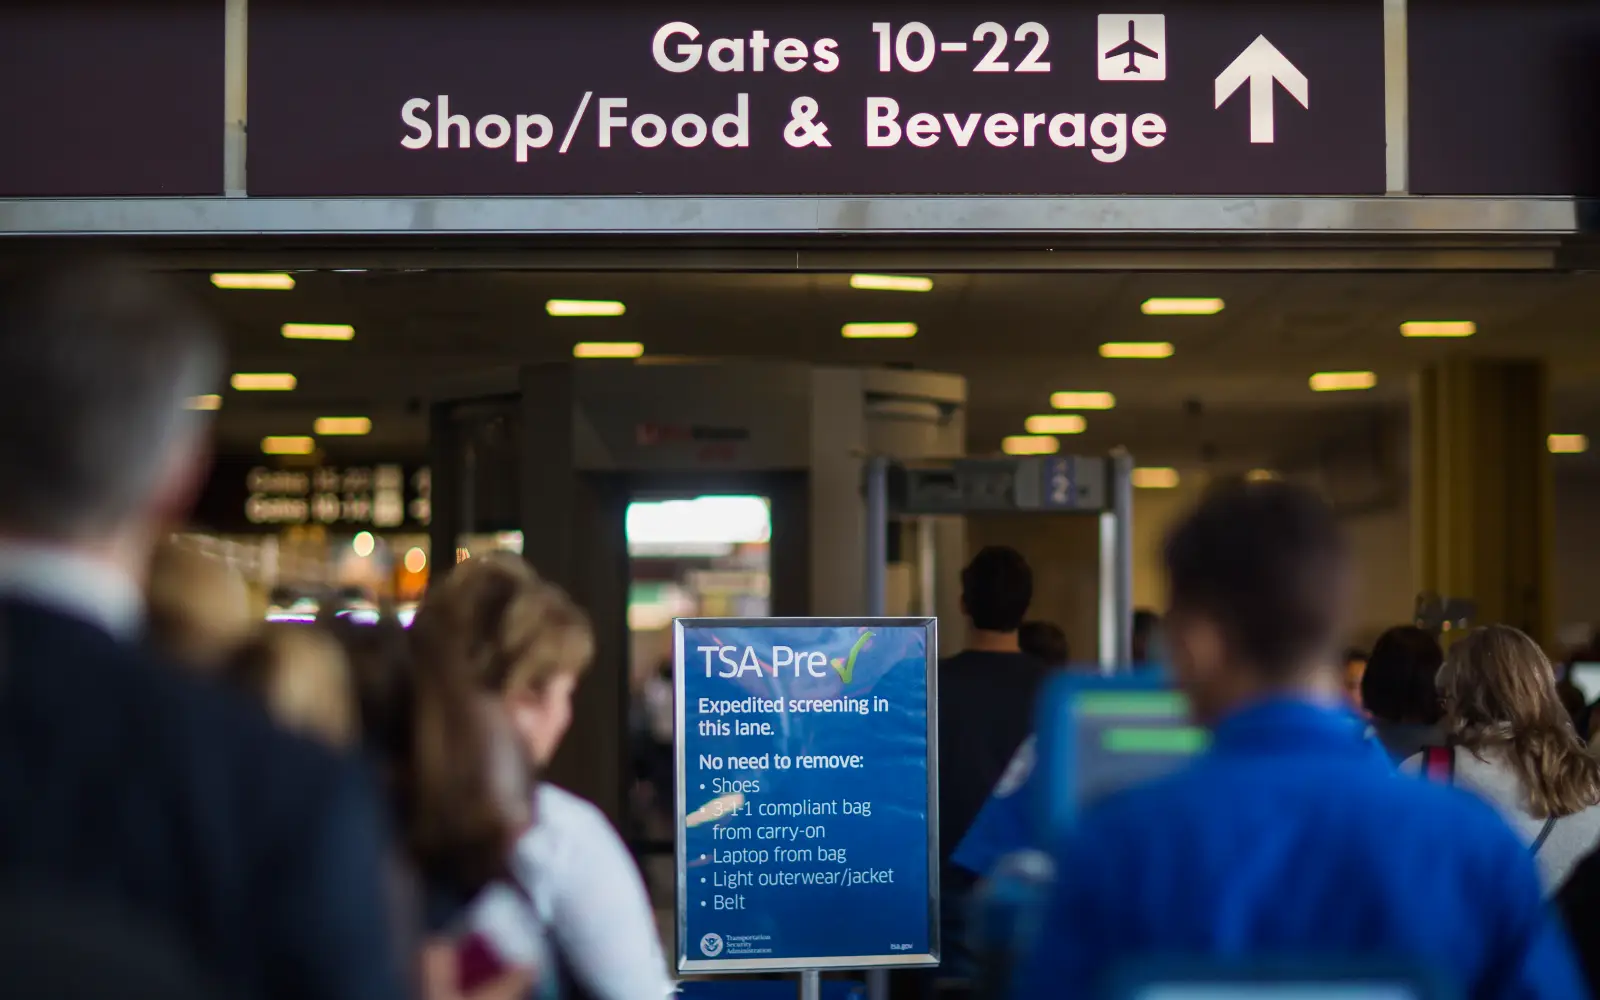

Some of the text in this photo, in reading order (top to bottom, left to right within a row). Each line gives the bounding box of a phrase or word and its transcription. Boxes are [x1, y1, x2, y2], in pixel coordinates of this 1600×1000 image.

[652, 22, 1051, 73] Gates 10-22
[400, 91, 1167, 163] Shop/Food & Beverage
[697, 645, 827, 678] TSA Pre
[699, 696, 889, 715] Expedited screening in
[698, 719, 775, 736] this lane.
[699, 753, 864, 770] No need to remove:
[712, 777, 760, 794] Shoes
[758, 799, 838, 818] compliant
[843, 799, 872, 817] bag
[712, 823, 826, 841] from carry-on
[713, 846, 847, 865] Laptop from bag
[713, 867, 894, 889] Light outerwear/jacket
[713, 895, 746, 910] Belt
[726, 934, 771, 942] Transportation
